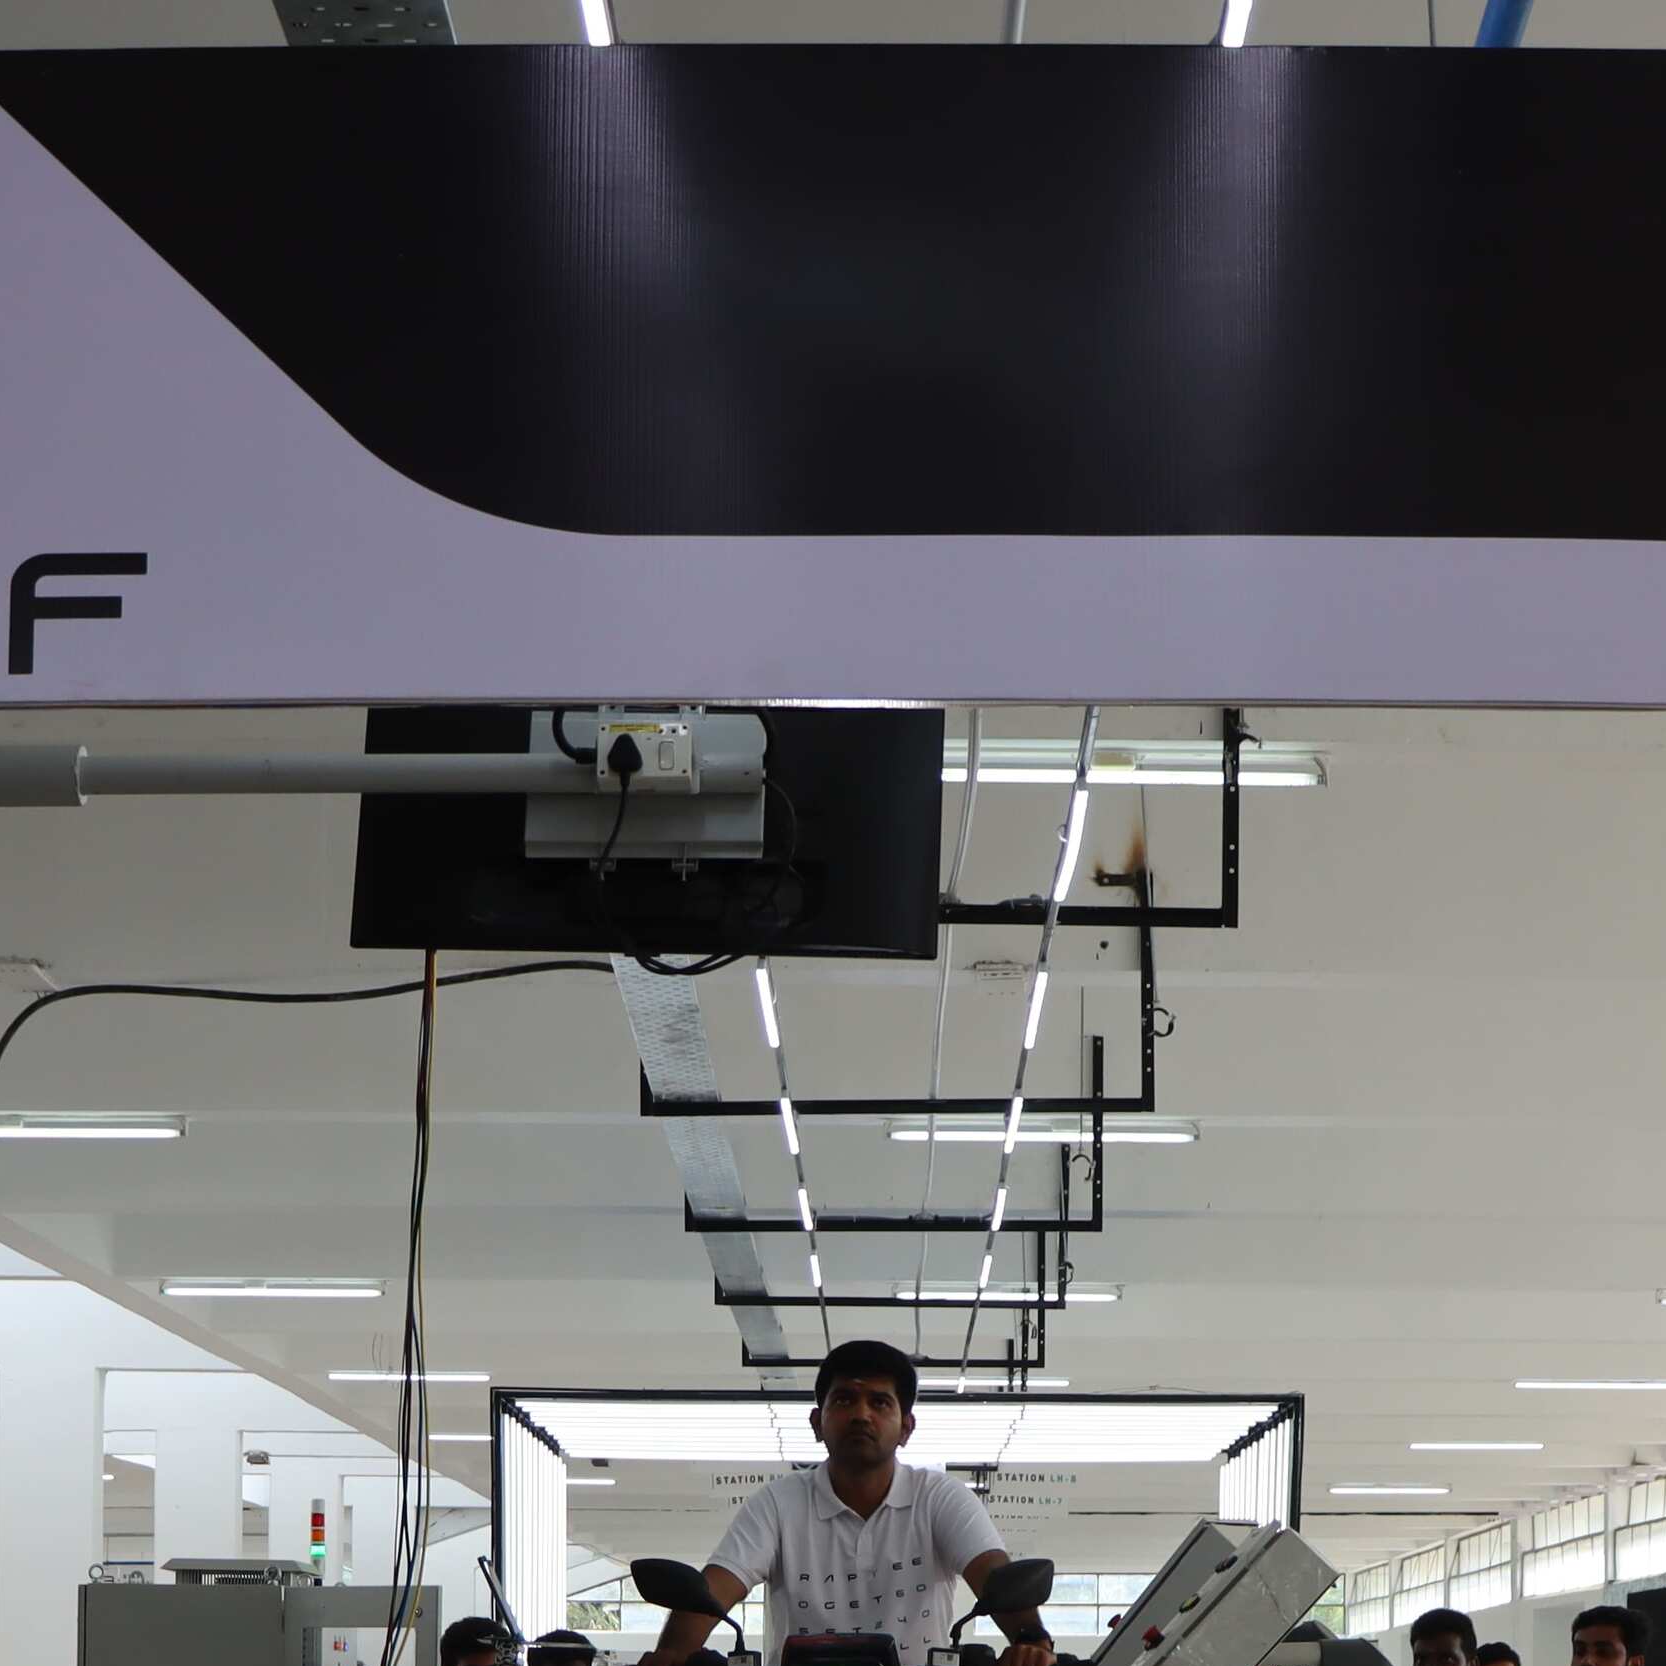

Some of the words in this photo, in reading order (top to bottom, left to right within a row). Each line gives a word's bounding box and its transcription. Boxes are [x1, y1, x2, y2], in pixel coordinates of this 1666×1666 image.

[716, 1474, 764, 1485] STATION
[997, 1473, 1045, 1483] STATION
[989, 1495, 1034, 1505] STATION
